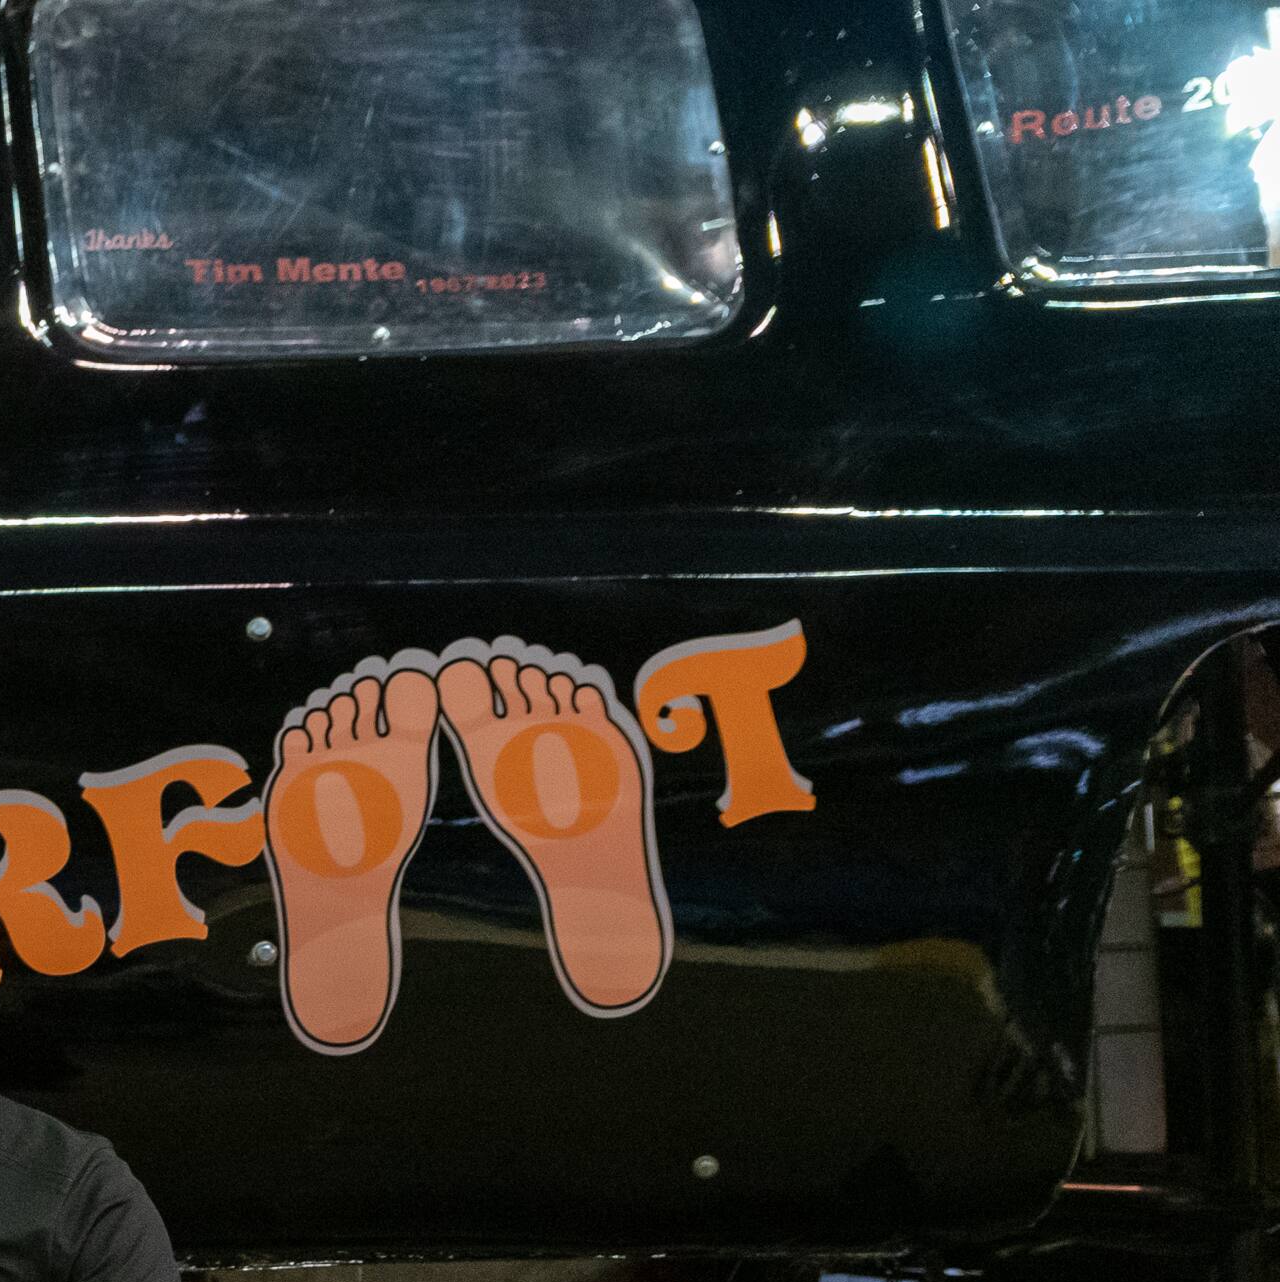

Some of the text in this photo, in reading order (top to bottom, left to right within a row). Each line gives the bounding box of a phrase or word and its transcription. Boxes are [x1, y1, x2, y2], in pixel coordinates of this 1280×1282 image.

[1009, 94, 1163, 144] Route
[83, 228, 175, 252] Thanks
[184, 258, 263, 285] Tim
[275, 257, 407, 284] Mente
